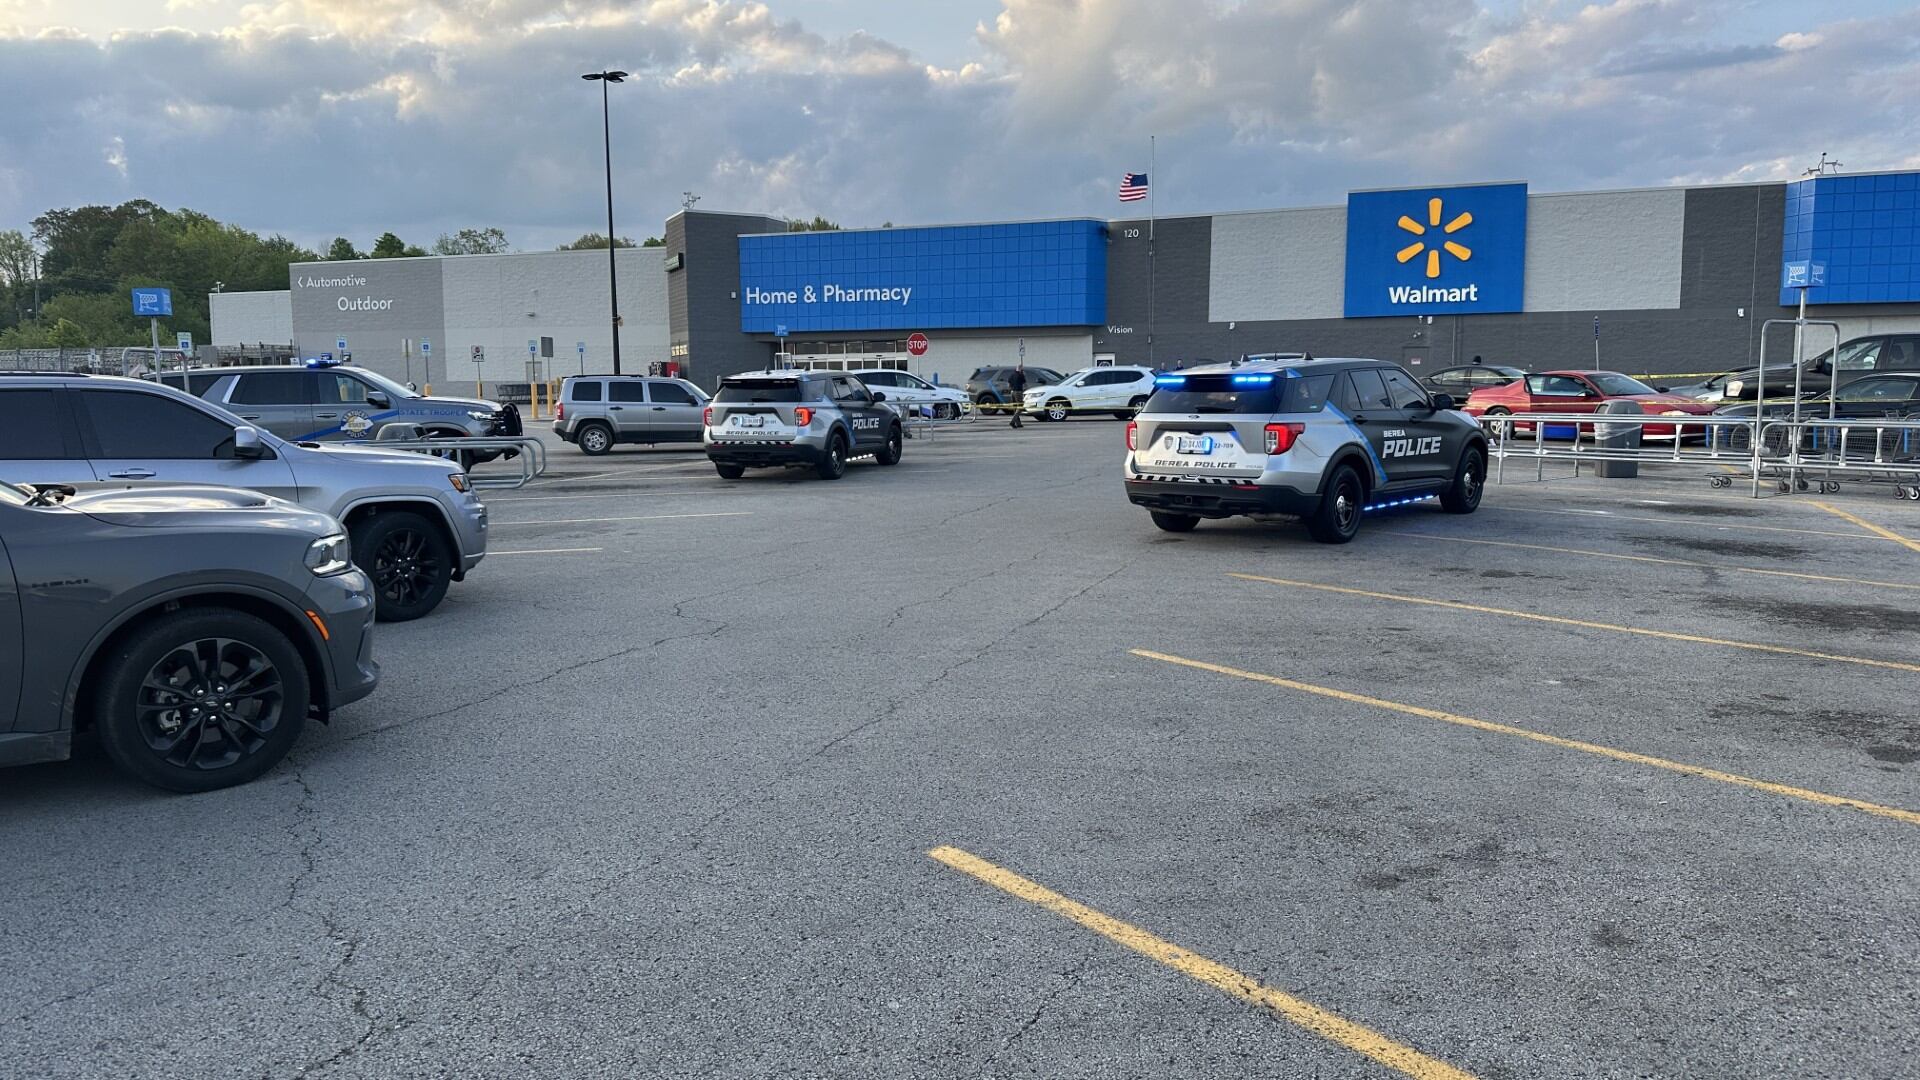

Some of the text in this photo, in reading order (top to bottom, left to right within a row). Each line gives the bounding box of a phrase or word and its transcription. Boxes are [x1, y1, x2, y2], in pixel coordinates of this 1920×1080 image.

[1124, 229, 1139, 238] 120
[306, 274, 367, 288] Automotive
[746, 284, 912, 306] Home & Pharmacy
[1388, 283, 1478, 304] Walmart
[337, 296, 393, 311] Outdoor
[1107, 325, 1133, 334] Vision
[908, 340, 927, 350] STOP
[852, 417, 880, 430] POLICE
[1383, 429, 1406, 438] BEREA
[1382, 436, 1442, 459] POLICE
[1154, 459, 1189, 467] BEREA
[1194, 461, 1238, 469] POLICE
